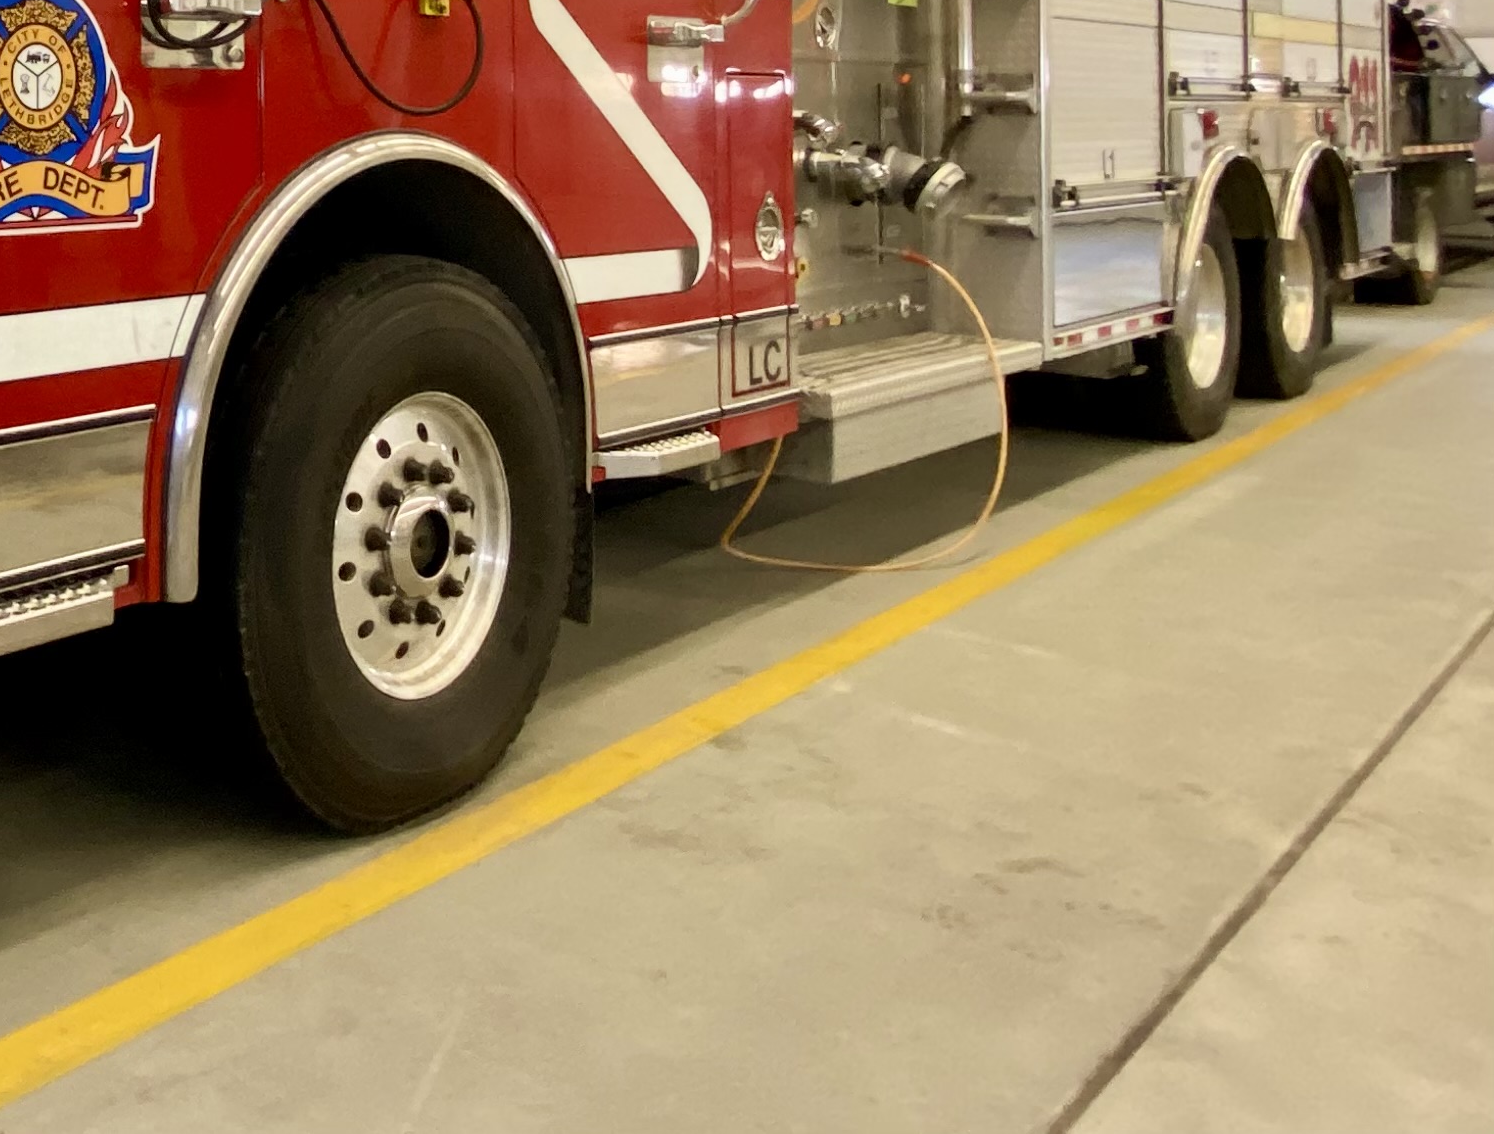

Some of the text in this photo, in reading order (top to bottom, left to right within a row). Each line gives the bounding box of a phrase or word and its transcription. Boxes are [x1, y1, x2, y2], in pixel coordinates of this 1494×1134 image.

[7, 28, 66, 54] CITY OF
[0, 77, 74, 125] LETHBRIDGE
[43, 166, 106, 211] DEPT.
[748, 339, 782, 386] LC
